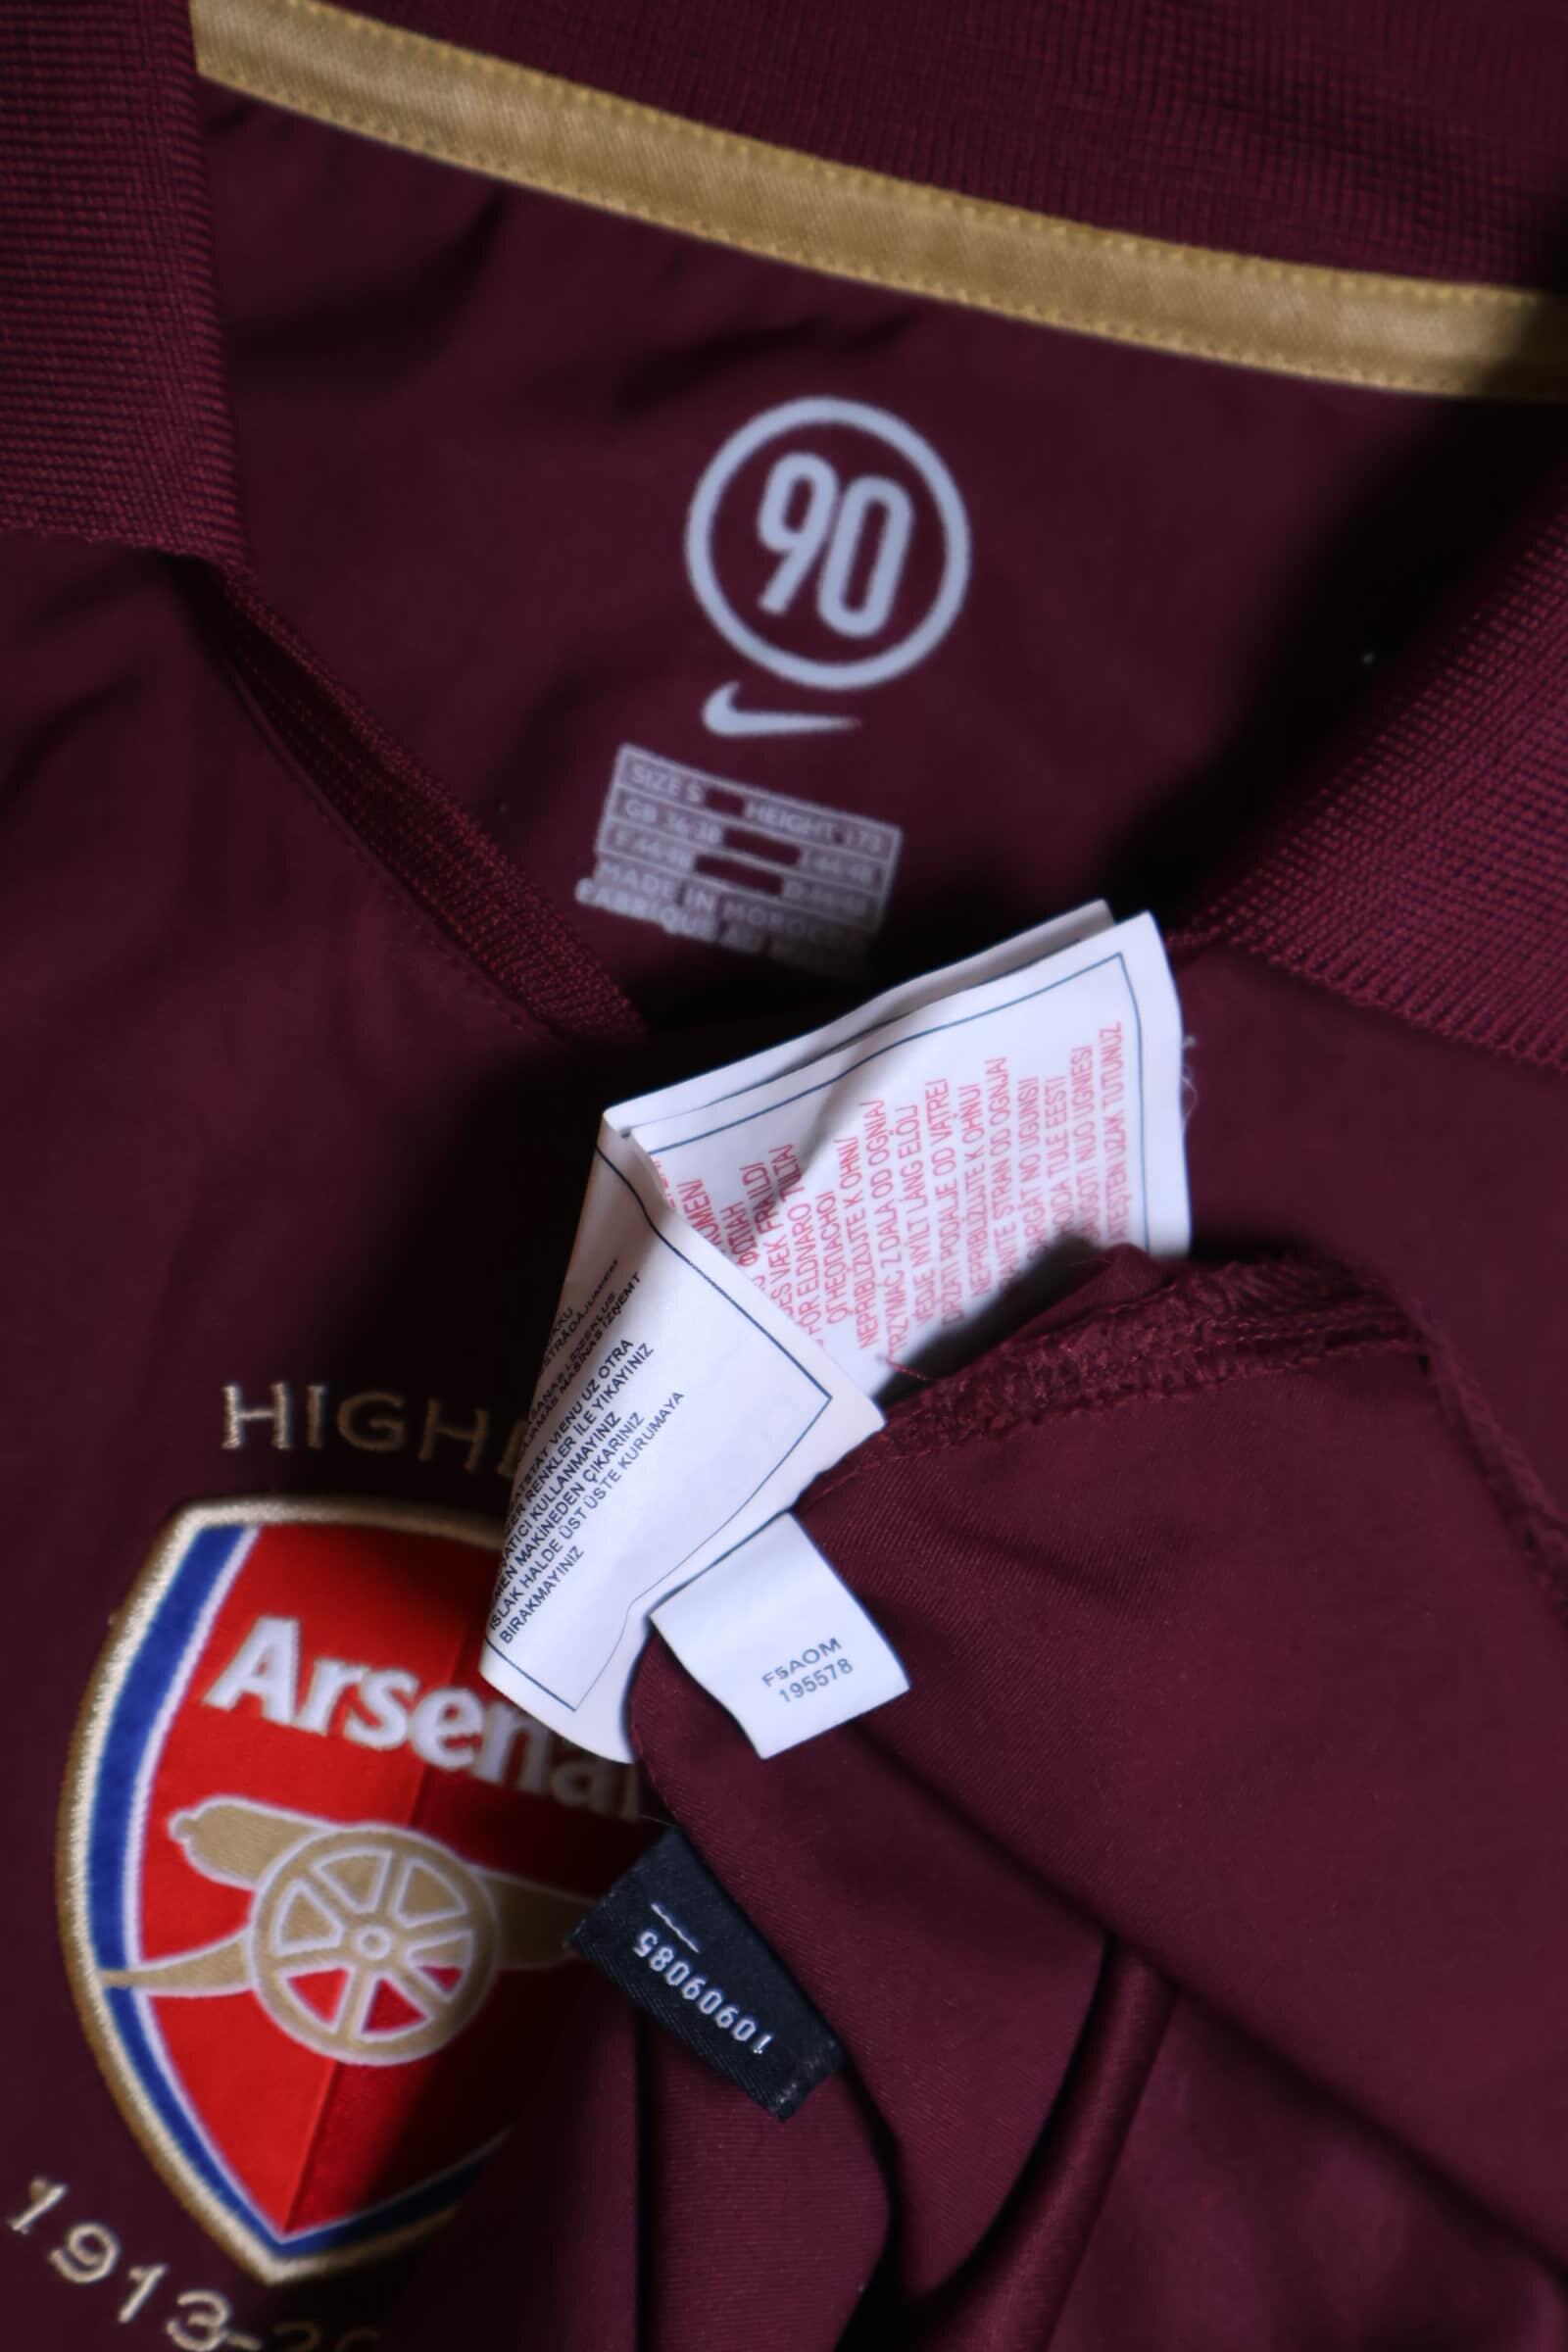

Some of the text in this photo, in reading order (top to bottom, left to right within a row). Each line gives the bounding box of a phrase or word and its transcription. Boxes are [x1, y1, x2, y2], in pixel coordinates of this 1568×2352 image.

[758, 450, 913, 638] 90
[631, 764, 681, 796] SIZE
[623, 798, 660, 823] GB
[597, 860, 674, 899] MADE
[686, 887, 714, 910] IN
[963, 1144, 983, 1163] K
[989, 1127, 1011, 1156] OD
[1046, 1129, 1070, 1178] TULE
[1072, 1119, 1096, 1163] NUO
[1102, 1108, 1125, 1159] UZAK
[870, 1167, 893, 1199] OD
[932, 1146, 955, 1176] OD
[1017, 1152, 1042, 1183] NO
[842, 1190, 863, 1208] K
[990, 1157, 1014, 1220] STRAN
[752, 1197, 783, 1234] FRA
[873, 1200, 899, 1250] DALA
[934, 1178, 961, 1258] PODALJE
[762, 1234, 792, 1284] VÆK
[880, 1252, 901, 1267] Z
[548, 1400, 584, 1444] VIENU
[580, 1378, 600, 1400] UZ
[596, 1341, 633, 1380] OTRA
[222, 1383, 529, 1478] HIGH
[522, 1435, 577, 1503] RENKLER
[570, 1410, 596, 1436] İLE
[591, 1342, 654, 1407] YIKAYINIZ
[514, 1482, 585, 1566] MAKİNEDEN
[580, 1410, 645, 1483] ÇIKARINIZ
[518, 1538, 564, 1588] HALDE
[556, 1505, 588, 1540] ÜST
[580, 1468, 622, 1510] ÜSTE
[615, 1391, 685, 1471] KURUMAYA
[527, 1410, 620, 1521] KULLANMAYINIZ
[498, 1544, 585, 1643] BIRAKMAYINIZ
[778, 1656, 854, 1703] 195578
[202, 1615, 641, 1825] Arsenal
[629, 1926, 776, 2057] 10909085
